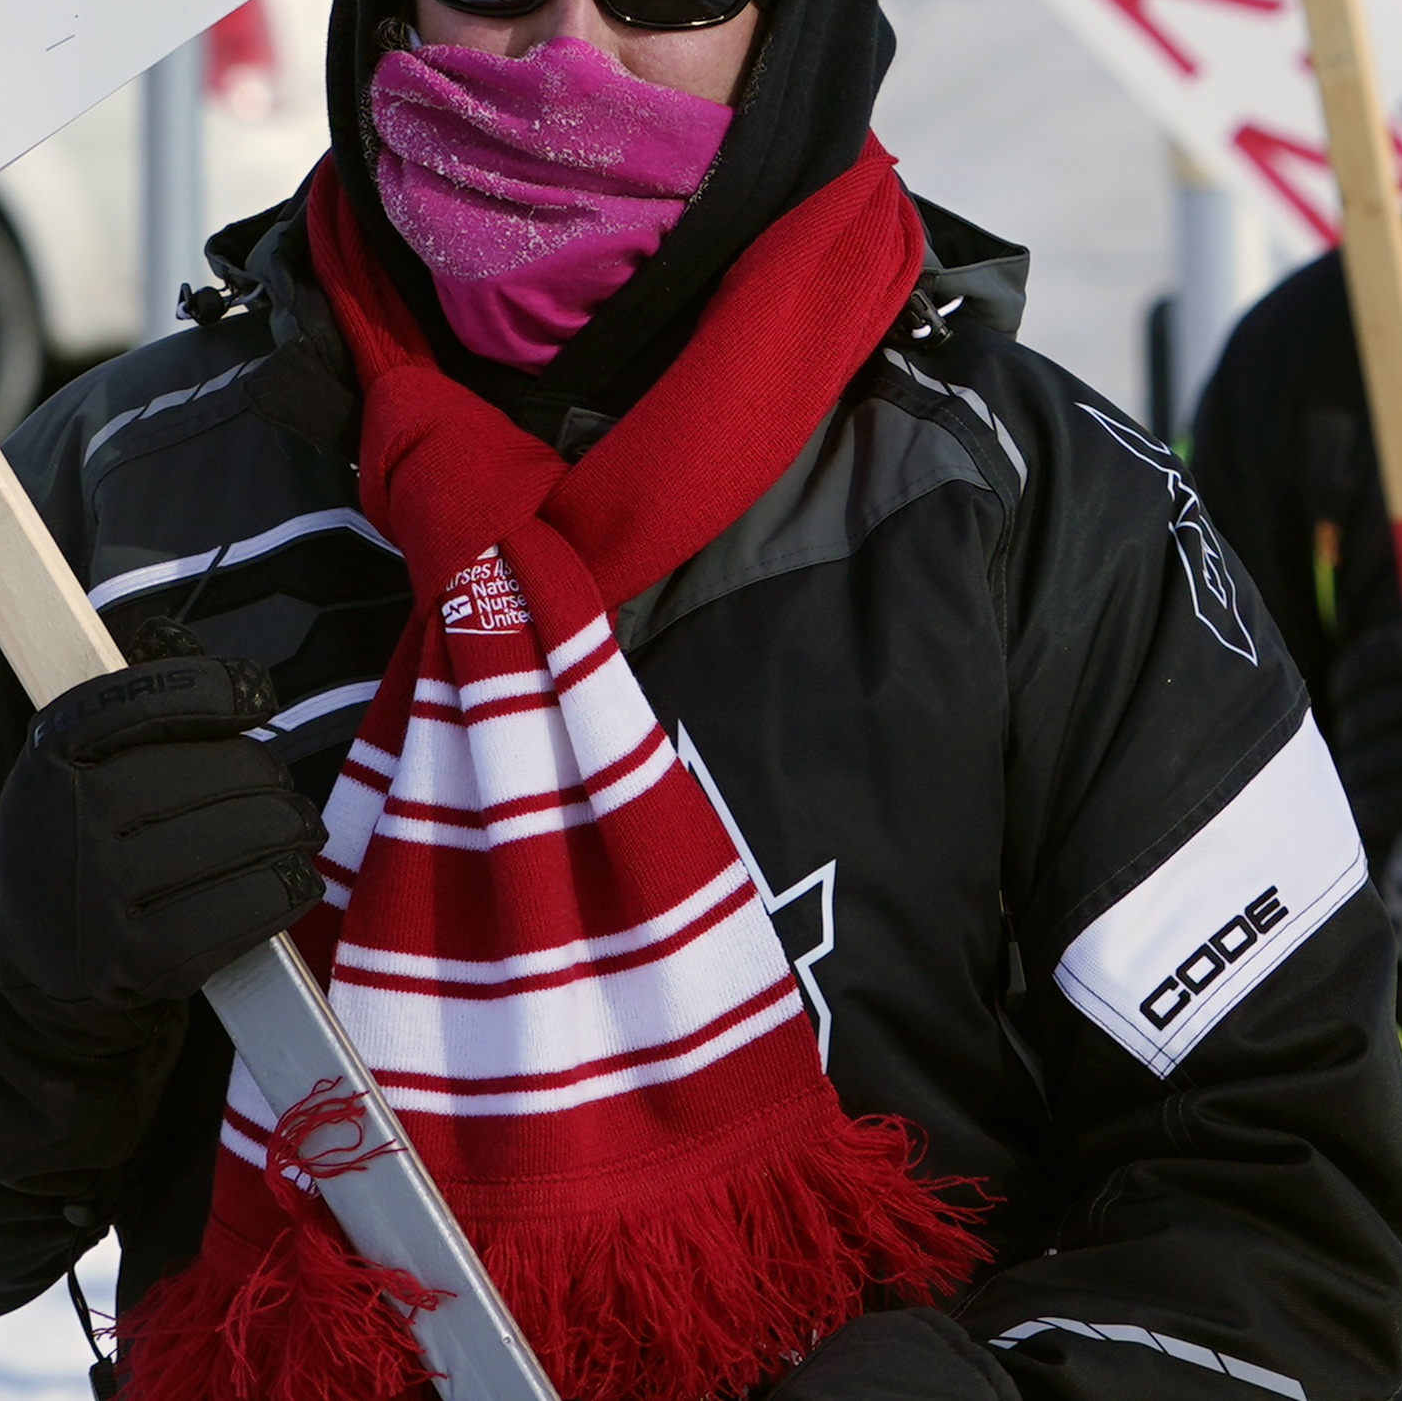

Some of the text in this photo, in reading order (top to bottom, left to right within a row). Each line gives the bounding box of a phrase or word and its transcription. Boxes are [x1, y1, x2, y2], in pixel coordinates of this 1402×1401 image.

[442, 561, 492, 592] urses
[470, 575, 521, 599] Natio
[476, 593, 528, 613] Nurse
[1139, 884, 1290, 1032] CODE
